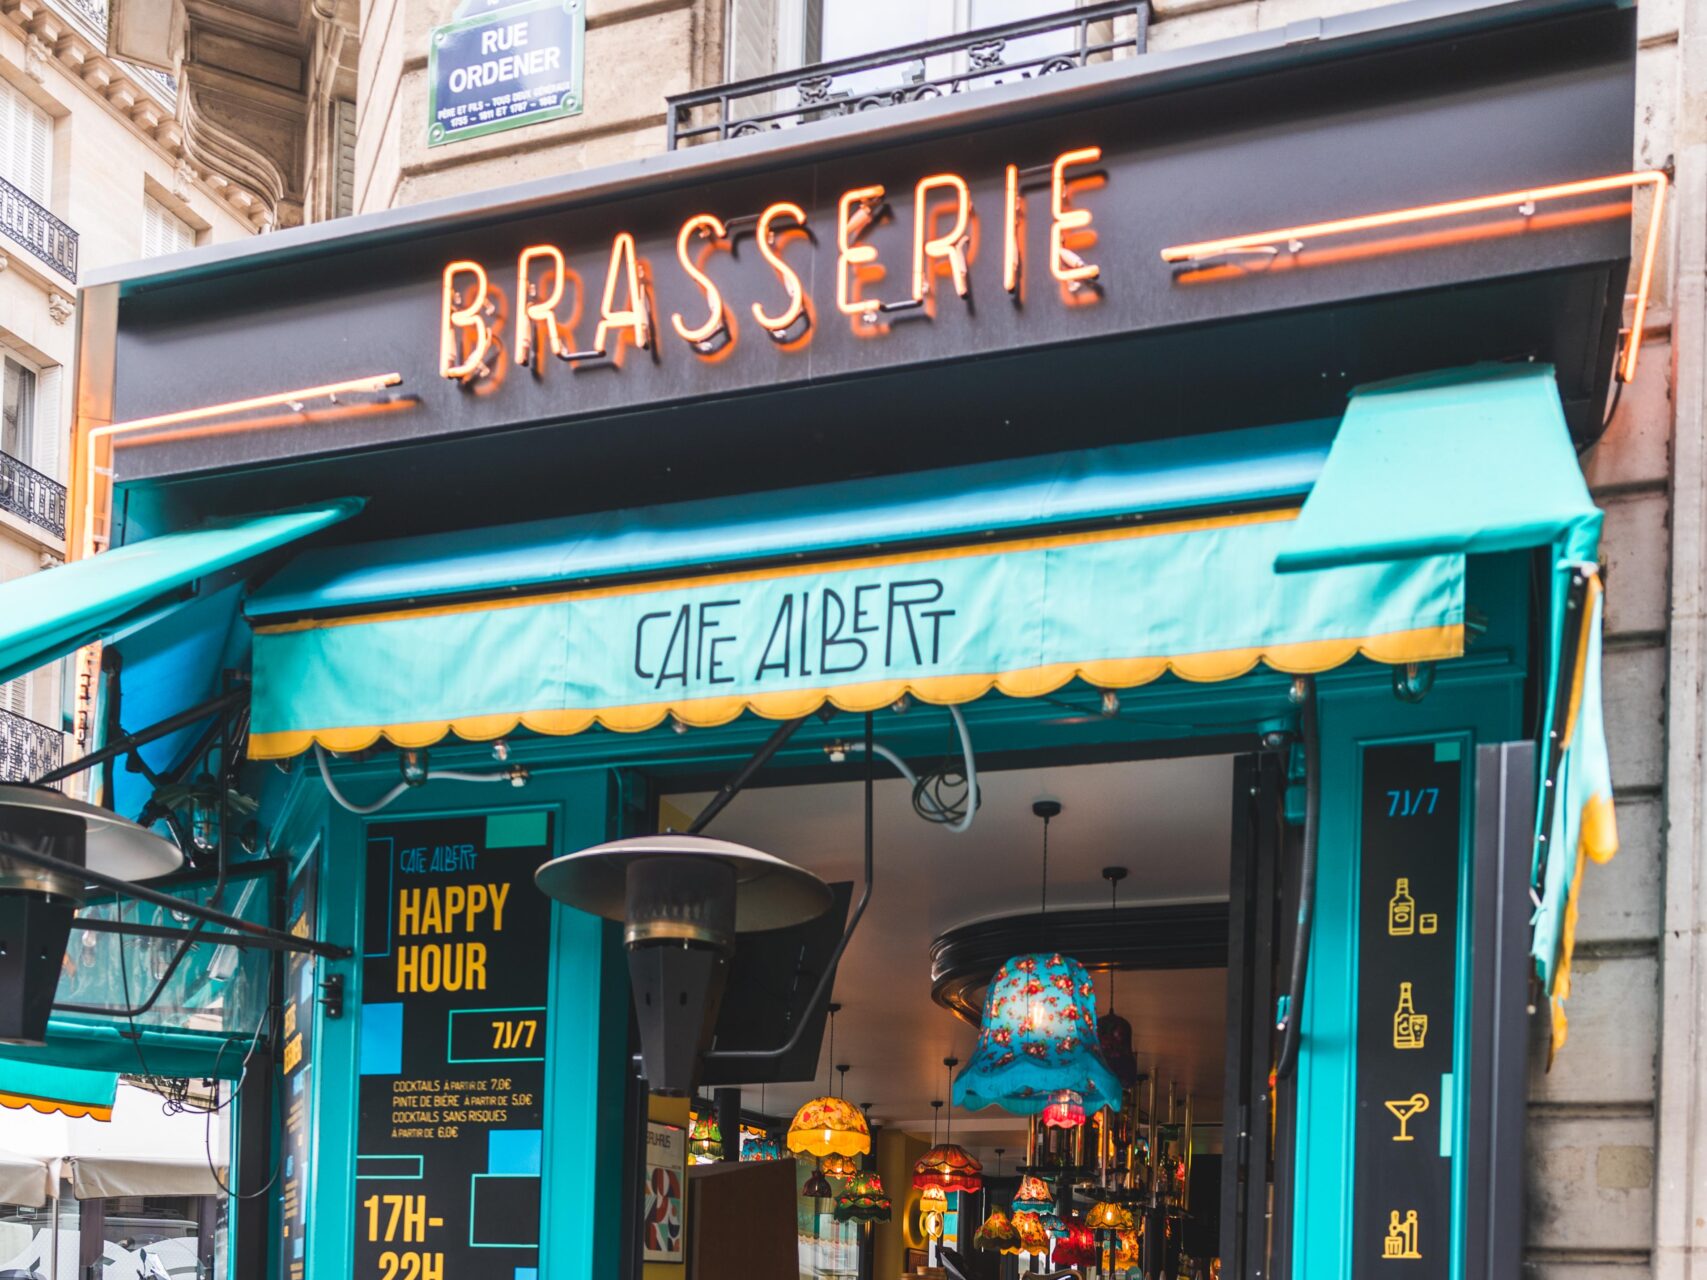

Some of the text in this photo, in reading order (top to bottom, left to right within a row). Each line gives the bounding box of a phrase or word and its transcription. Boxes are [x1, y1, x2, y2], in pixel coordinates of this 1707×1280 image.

[480, 21, 529, 55] RUE
[449, 46, 561, 93] ORDENER
[456, 104, 467, 116] ET
[468, 100, 484, 113] FILS
[496, 105, 508, 116] ET
[440, 147, 1101, 379] BRASSERIE
[634, 578, 956, 690] CAFE ALBERT
[1386, 787, 1440, 817] 7J/7
[400, 844, 478, 874] CAFE ALBERT
[398, 882, 510, 936] HAPPY
[397, 942, 487, 993] HOUR
[492, 1020, 537, 1050] 7J/7
[393, 1080, 440, 1092] COCKTAILS
[451, 1081, 476, 1091] PARTIR
[477, 1080, 488, 1090] DE
[393, 1095, 418, 1107] PINTE
[420, 1095, 432, 1107] DE
[434, 1092, 460, 1107] BIÈRE
[471, 1096, 496, 1106] PARTIR
[498, 1095, 508, 1106] DE
[392, 1109, 507, 1123] COCKTAILS SANS RISQUES
[399, 1128, 423, 1138] PARTIR
[424, 1127, 434, 1138] DE
[363, 1194, 444, 1242] 17H-
